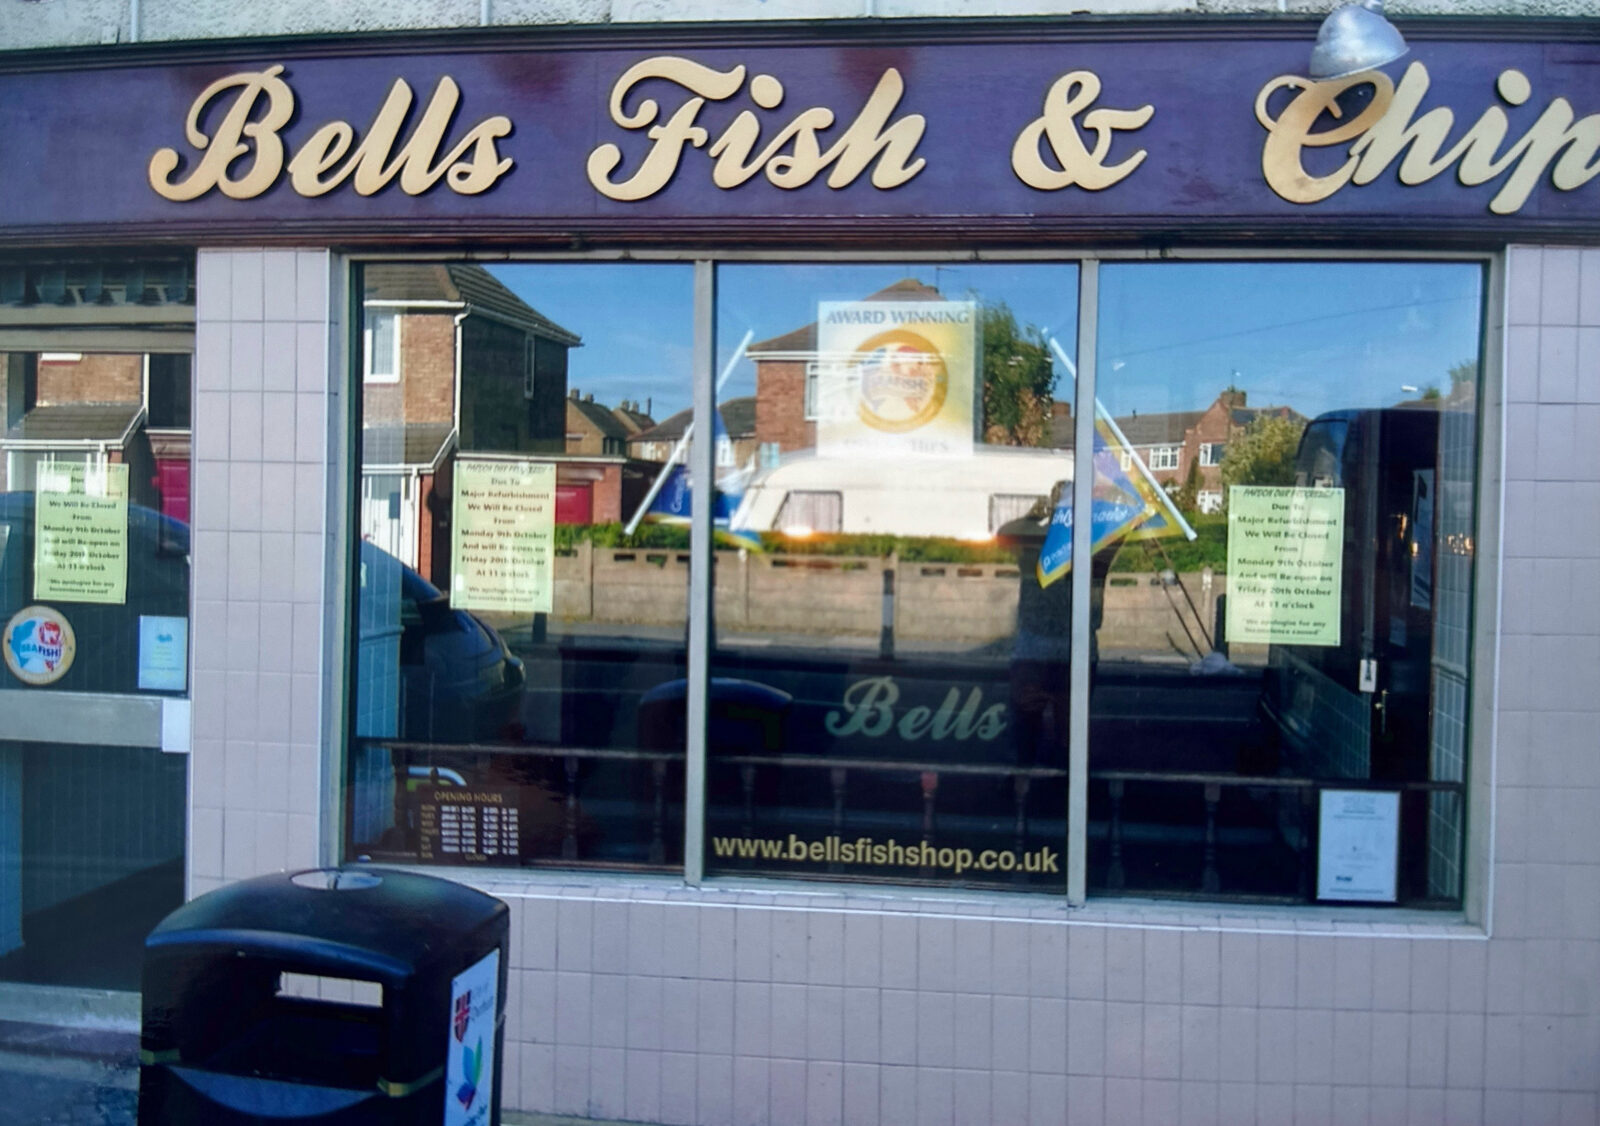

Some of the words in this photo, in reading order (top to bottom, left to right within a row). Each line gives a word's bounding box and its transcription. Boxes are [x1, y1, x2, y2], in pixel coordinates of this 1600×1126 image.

[149, 65, 514, 201] Bells
[587, 55, 927, 201] Fish
[1011, 70, 1155, 190] &
[826, 310, 887, 324] AWARD
[890, 310, 970, 324] WINNING
[461, 489, 486, 498] Major
[488, 490, 550, 500] Refurbishment
[91, 501, 117, 509] Closed
[467, 503, 481, 511] We
[483, 503, 501, 511] Will
[502, 504, 513, 512] Be
[515, 504, 543, 513] Closed
[1271, 503, 1290, 511] Due
[1294, 503, 1305, 511] To
[72, 513, 93, 521] From
[493, 517, 516, 525] From
[1237, 516, 1265, 525] Major
[1267, 516, 1337, 526] Refurbishment
[43, 525, 74, 534] Monday
[75, 525, 89, 533] 9th
[90, 526, 121, 534] October
[461, 529, 494, 539] Monday
[496, 530, 512, 538] 9th
[513, 530, 548, 539] October
[1244, 530, 1260, 538] We
[1262, 530, 1282, 538] Will
[1283, 531, 1296, 539] Be
[1298, 531, 1330, 540] Closed
[462, 542, 480, 550] And
[461, 555, 487, 564] Friday
[490, 556, 510, 564] 20th
[511, 556, 545, 566] October
[1237, 558, 1275, 567] Monday
[1277, 559, 1294, 567] 9th
[1296, 559, 1334, 568] October
[1239, 571, 1258, 579] And
[1237, 586, 1267, 595] Friday
[1270, 586, 1292, 595] 20th
[1294, 587, 1332, 596] October
[1281, 601, 1315, 609] o'clock
[824, 676, 1008, 741] Bells
[434, 791, 472, 802] OPENING
[473, 793, 503, 803] HOURS
[713, 834, 1060, 873] www.bellsfishshop.co.uk
